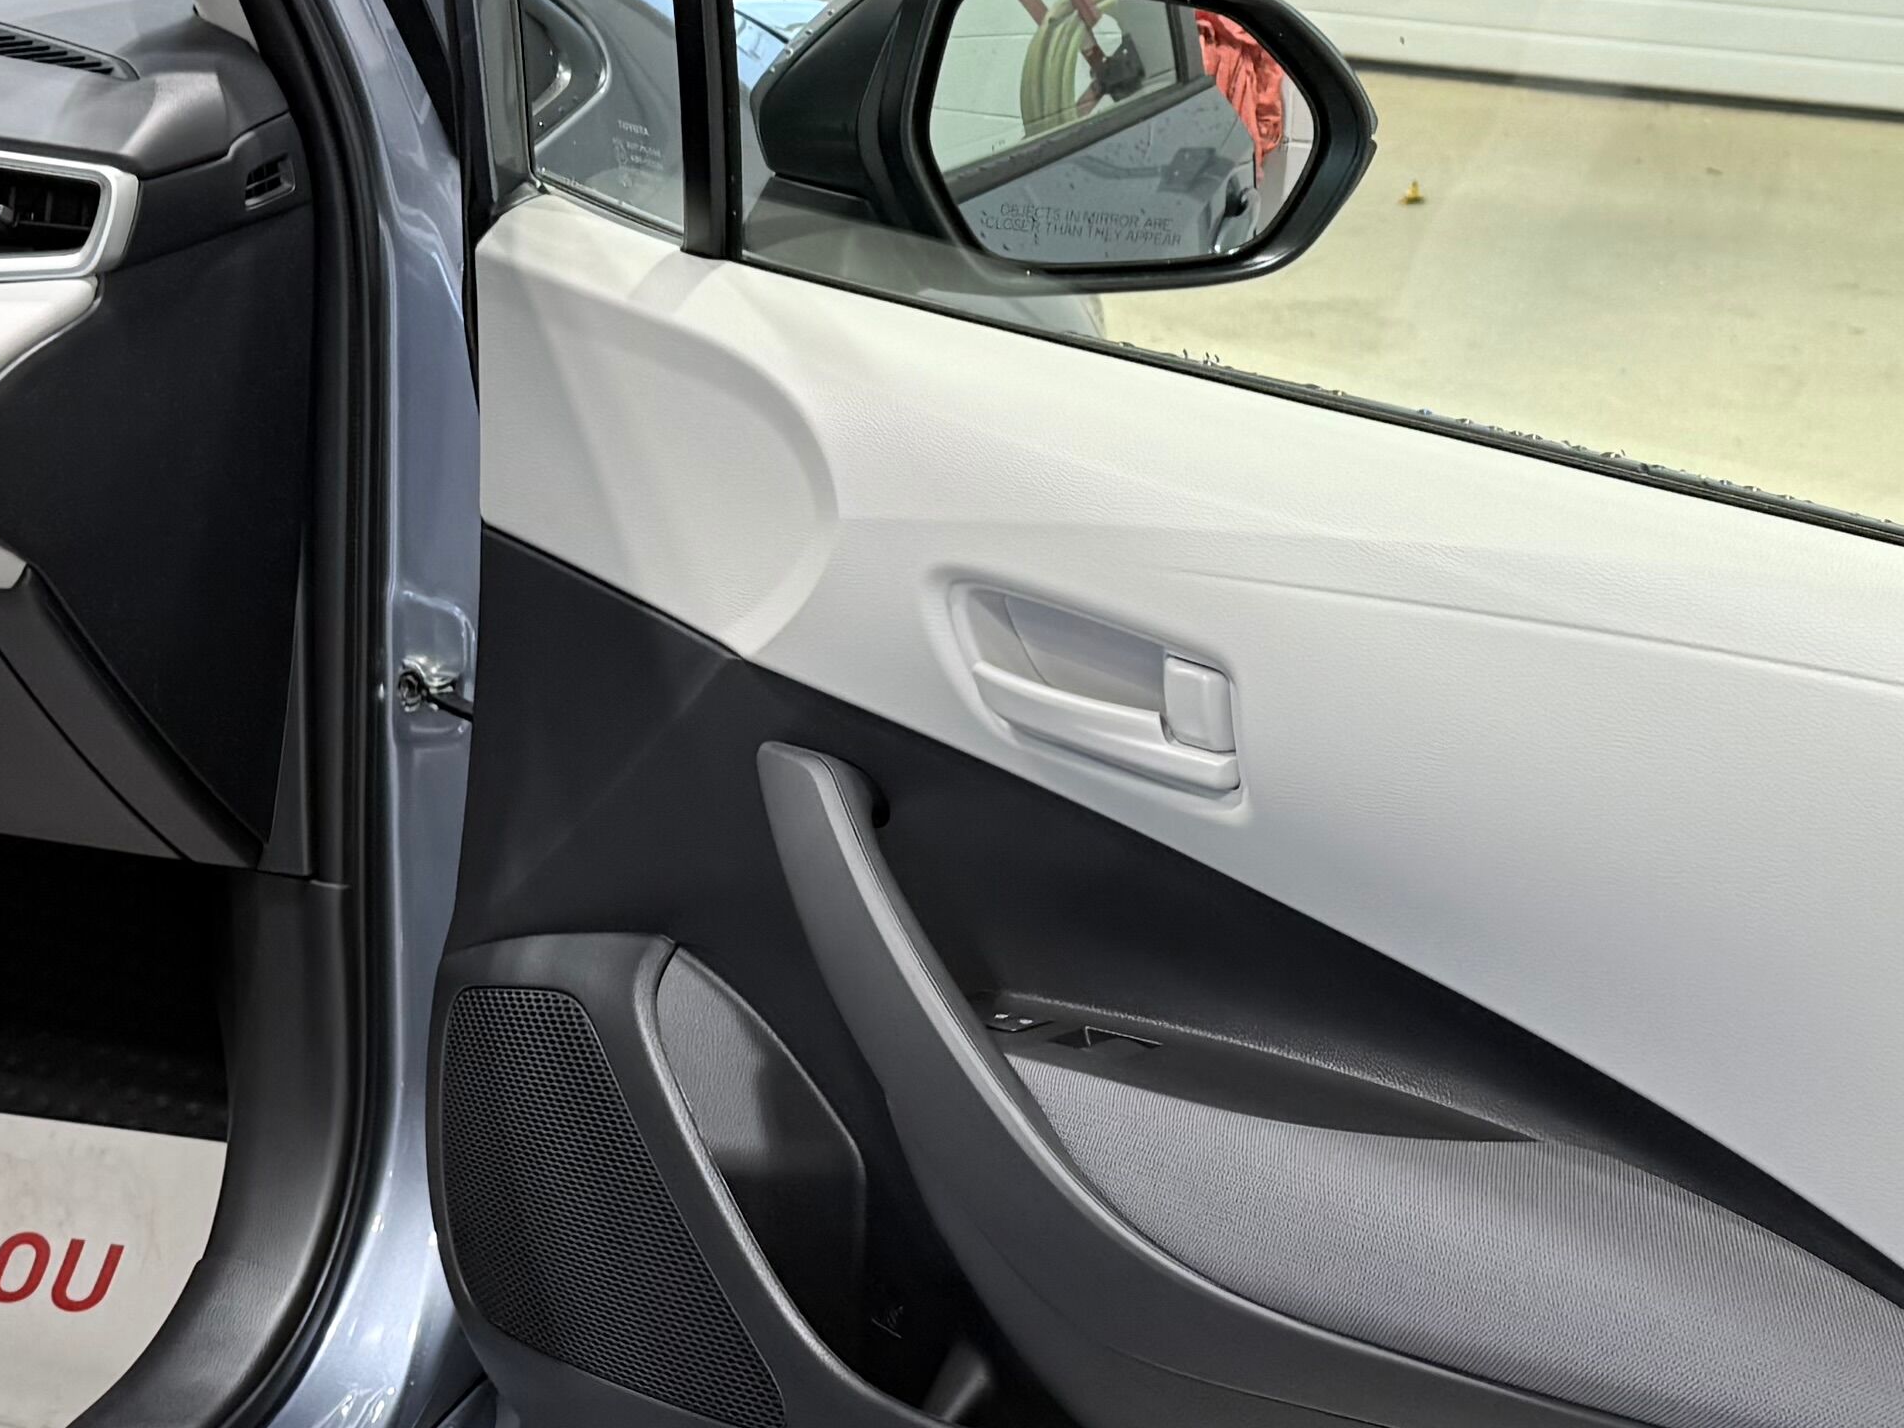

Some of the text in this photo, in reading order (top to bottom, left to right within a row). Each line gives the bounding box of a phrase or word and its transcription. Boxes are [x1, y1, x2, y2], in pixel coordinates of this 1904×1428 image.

[1000, 203, 1173, 232] OBJECTS IN MIRROR ARE
